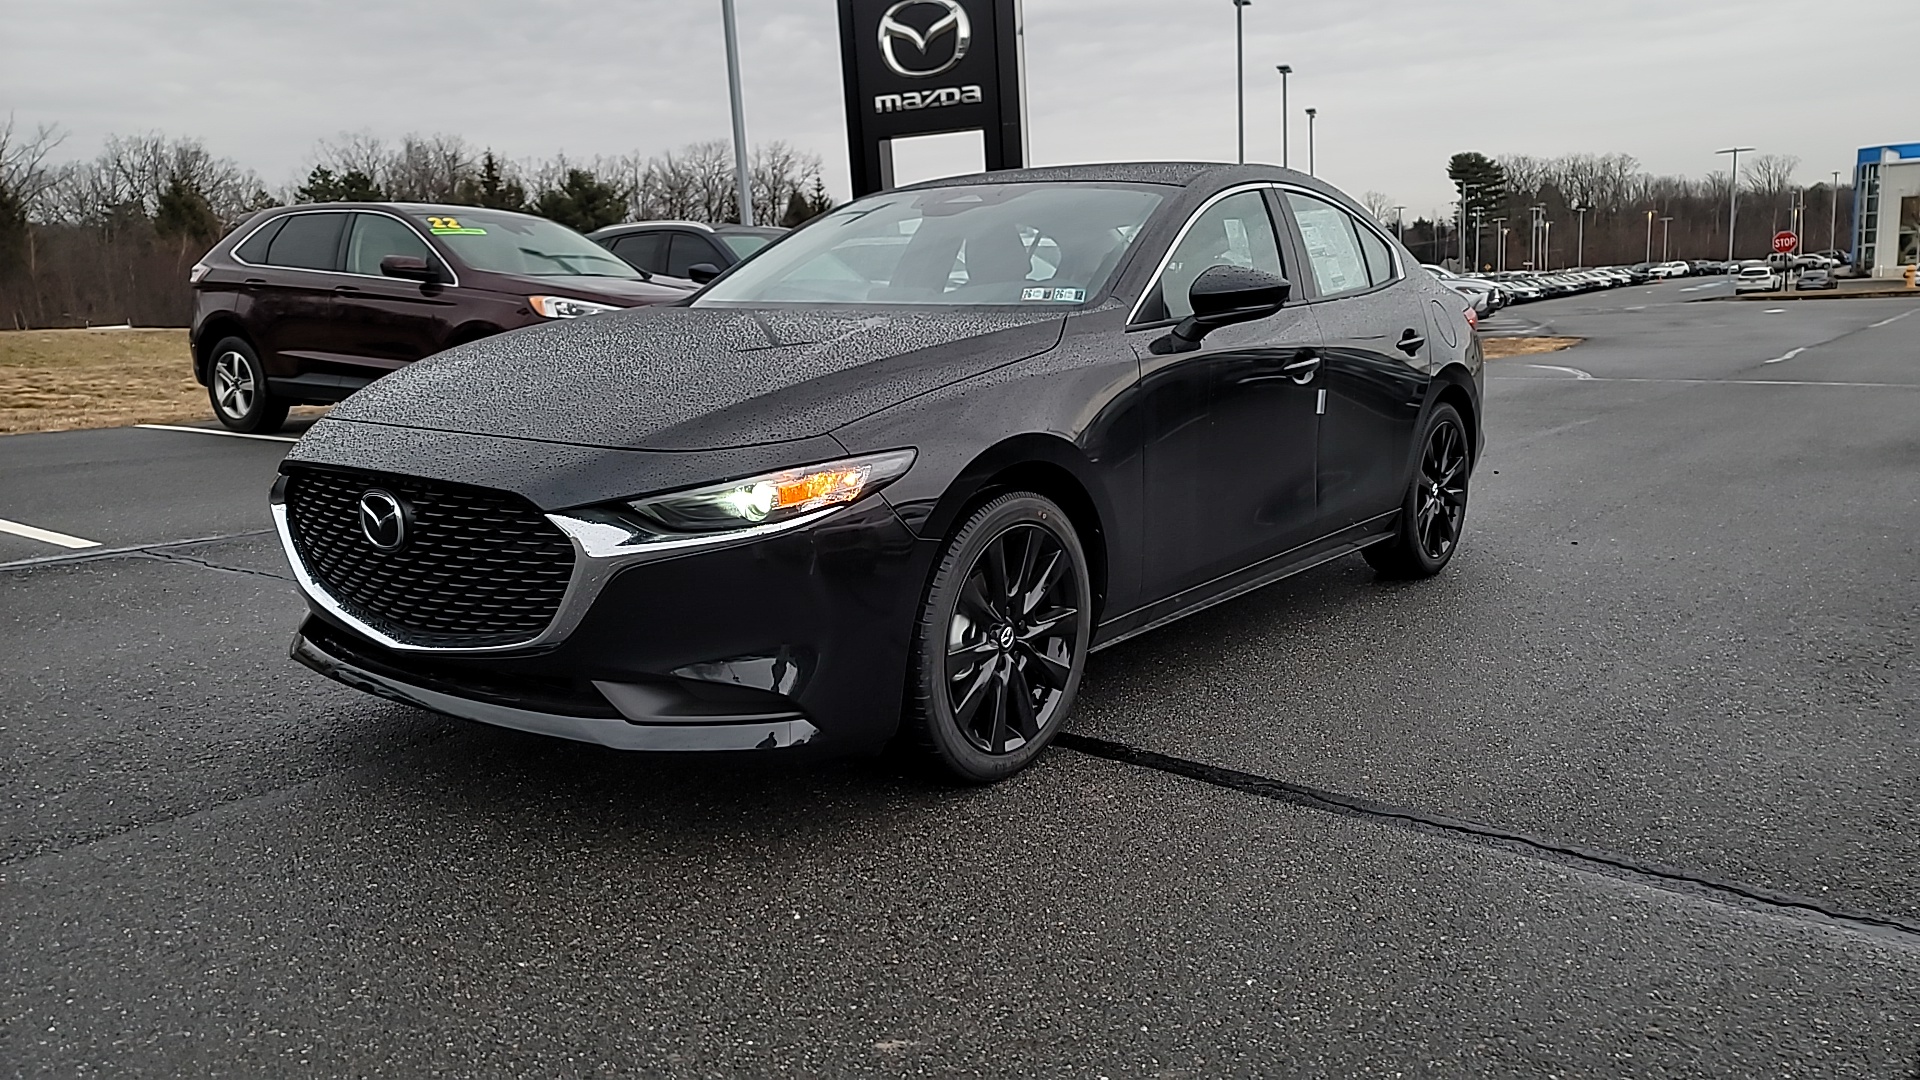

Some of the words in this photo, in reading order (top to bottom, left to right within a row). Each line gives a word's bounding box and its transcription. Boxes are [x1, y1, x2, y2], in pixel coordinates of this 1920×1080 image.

[874, 84, 982, 114] mazda
[427, 216, 462, 229] 22
[1775, 236, 1795, 248] STOP
